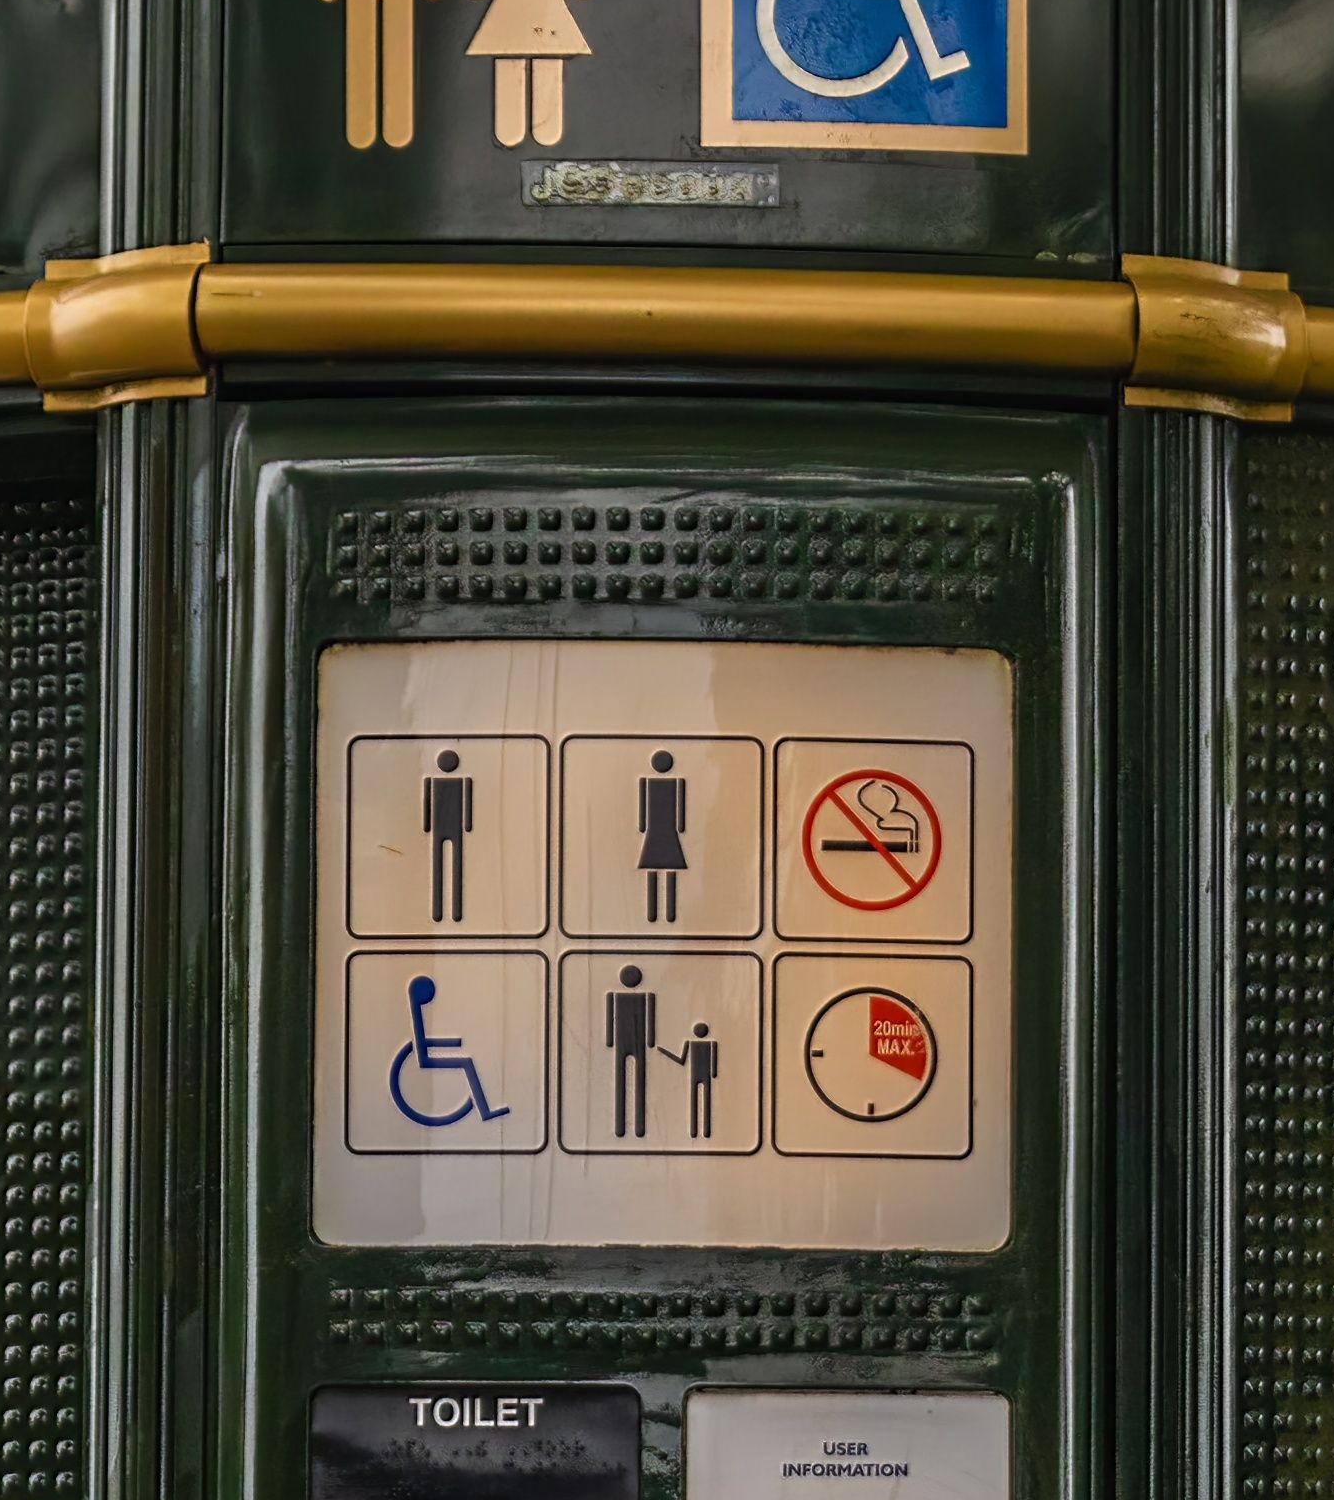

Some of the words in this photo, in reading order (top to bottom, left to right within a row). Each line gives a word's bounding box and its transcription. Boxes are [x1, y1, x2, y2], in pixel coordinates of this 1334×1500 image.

[877, 1038, 915, 1055] MAX.
[408, 1397, 544, 1427] TOILET
[823, 1442, 869, 1456] USER
[783, 1464, 910, 1477] INFORMATION
